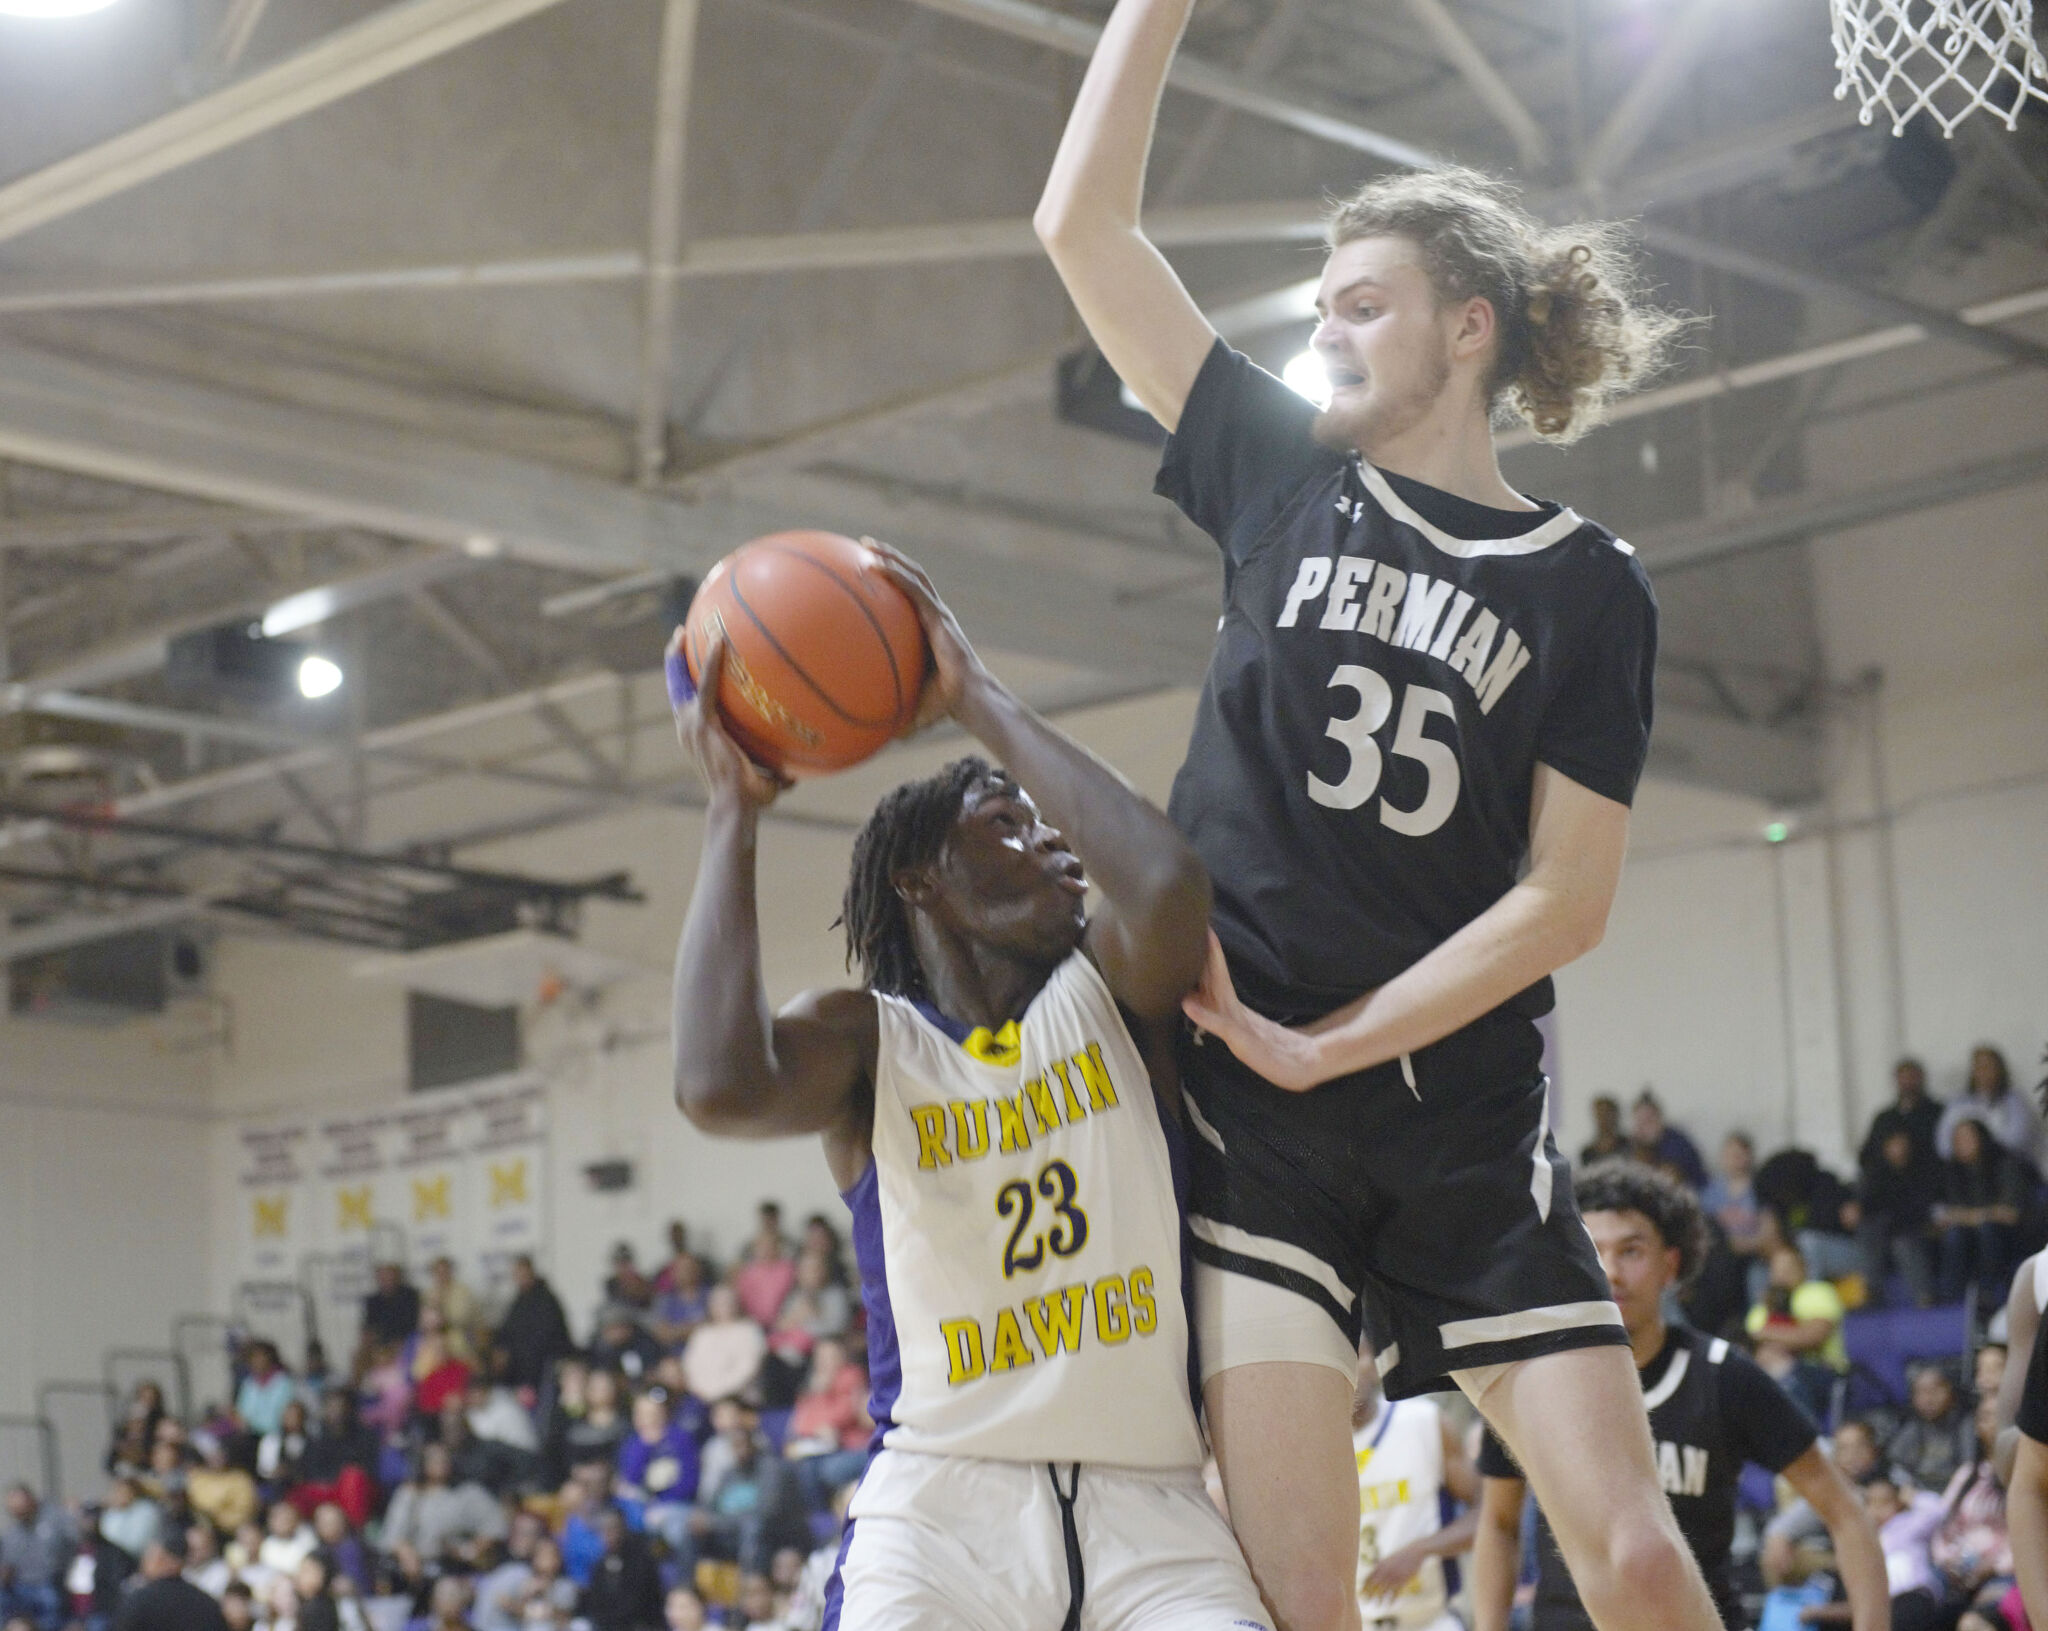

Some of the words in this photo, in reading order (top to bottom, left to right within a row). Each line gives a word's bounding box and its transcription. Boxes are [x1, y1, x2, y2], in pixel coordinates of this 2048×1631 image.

[1277, 555, 1532, 716] PERMIAN
[1307, 664, 1461, 837] 35
[909, 1040, 1120, 1171] RUNNIN
[995, 1158, 1089, 1281] 23
[939, 1265, 1159, 1387] DAWGS
